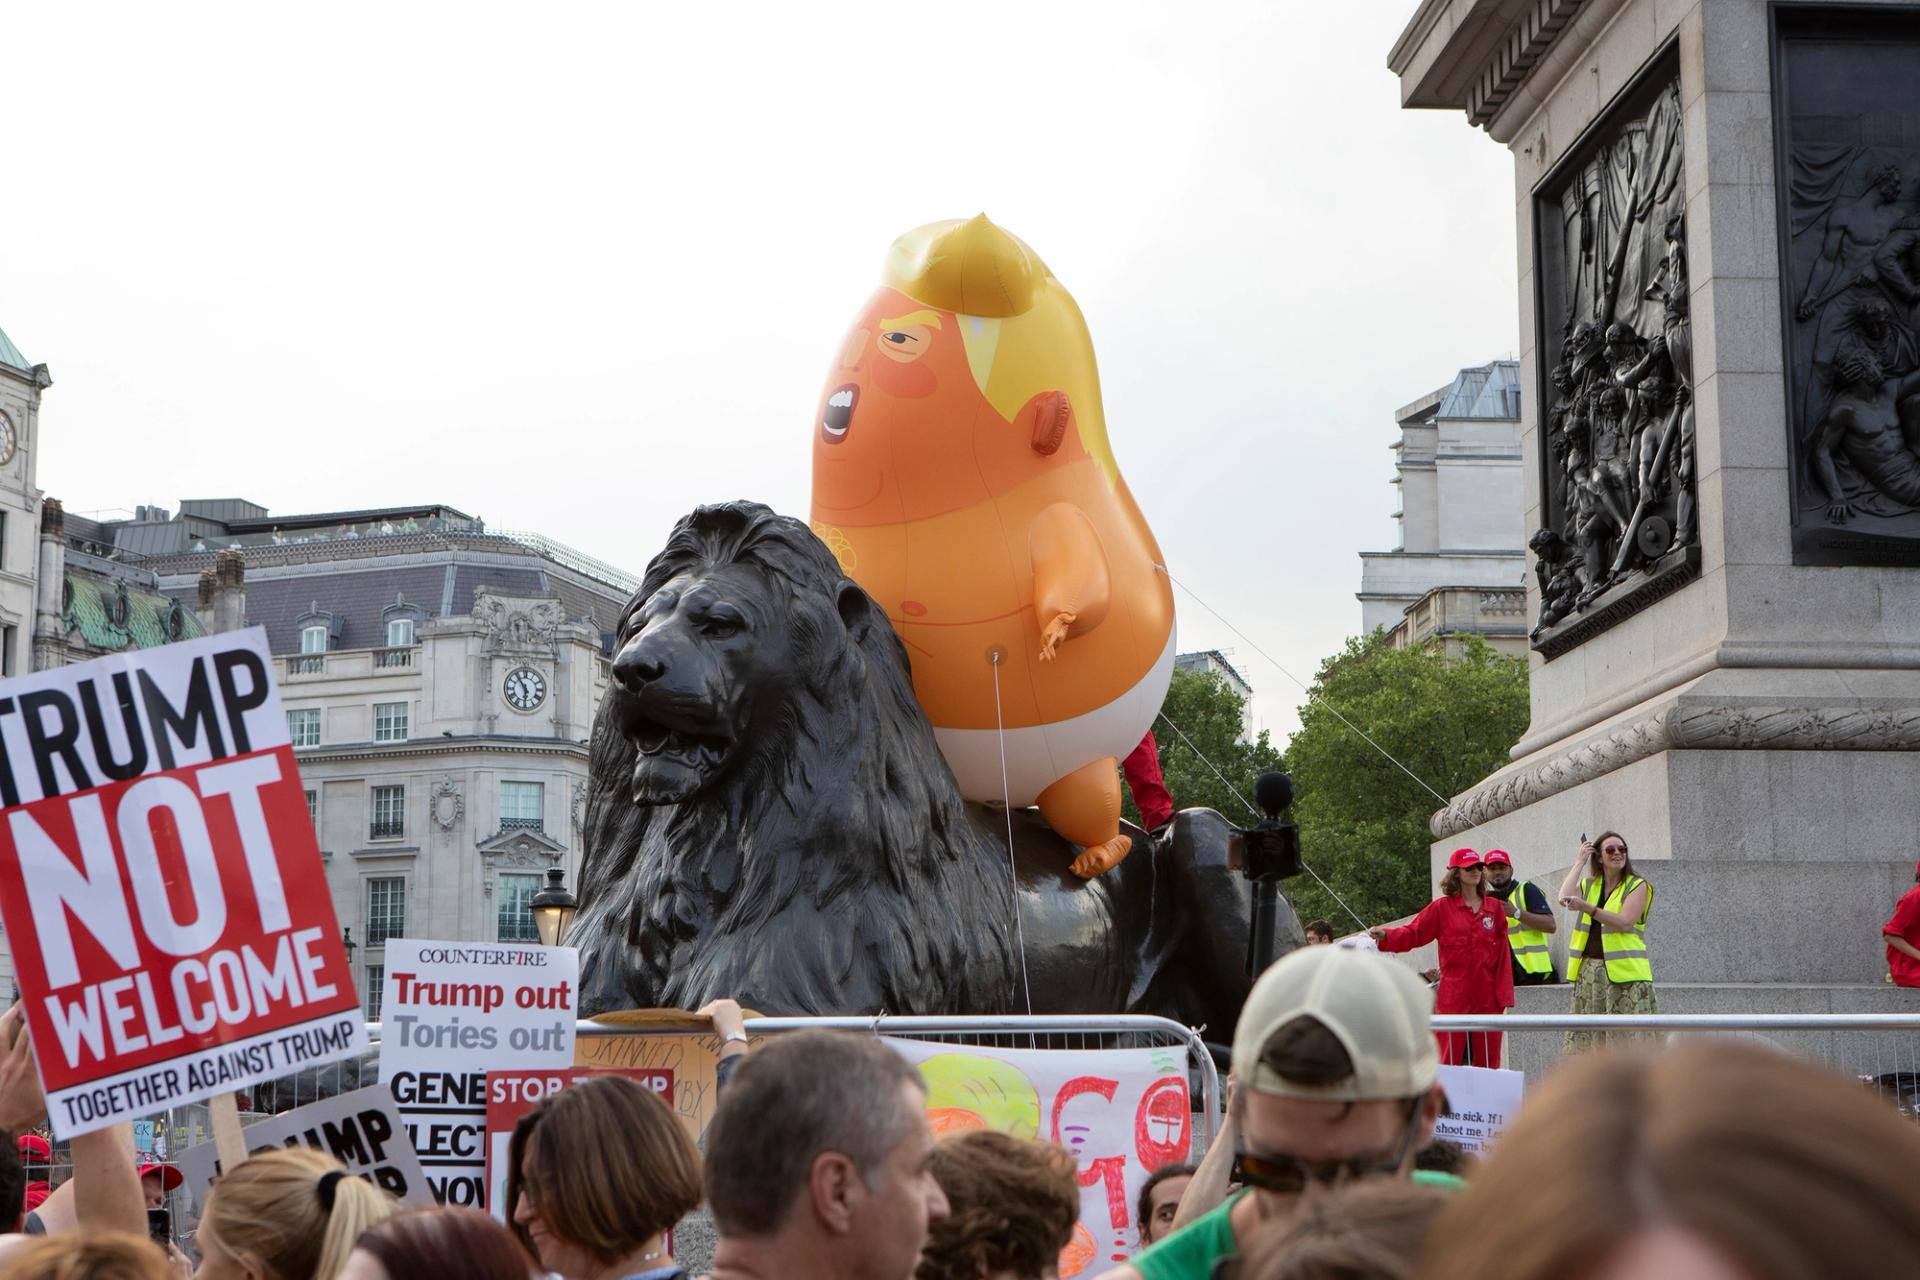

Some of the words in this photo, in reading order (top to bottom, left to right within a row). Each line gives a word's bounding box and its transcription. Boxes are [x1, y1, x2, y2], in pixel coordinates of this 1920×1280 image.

[8, 752, 292, 990] NOT
[419, 948, 548, 967] COUNTERFIRE
[44, 927, 338, 1069] WELCOME
[392, 972, 504, 1013] Trump
[515, 981, 571, 1011] out
[393, 1015, 498, 1050] Tories
[509, 1022, 565, 1051] out
[62, 1068, 181, 1126] TOGETHER
[188, 1043, 276, 1093] AGAINST
[278, 1020, 354, 1066] TRUMP
[1435, 1122, 1463, 1136] shoot
